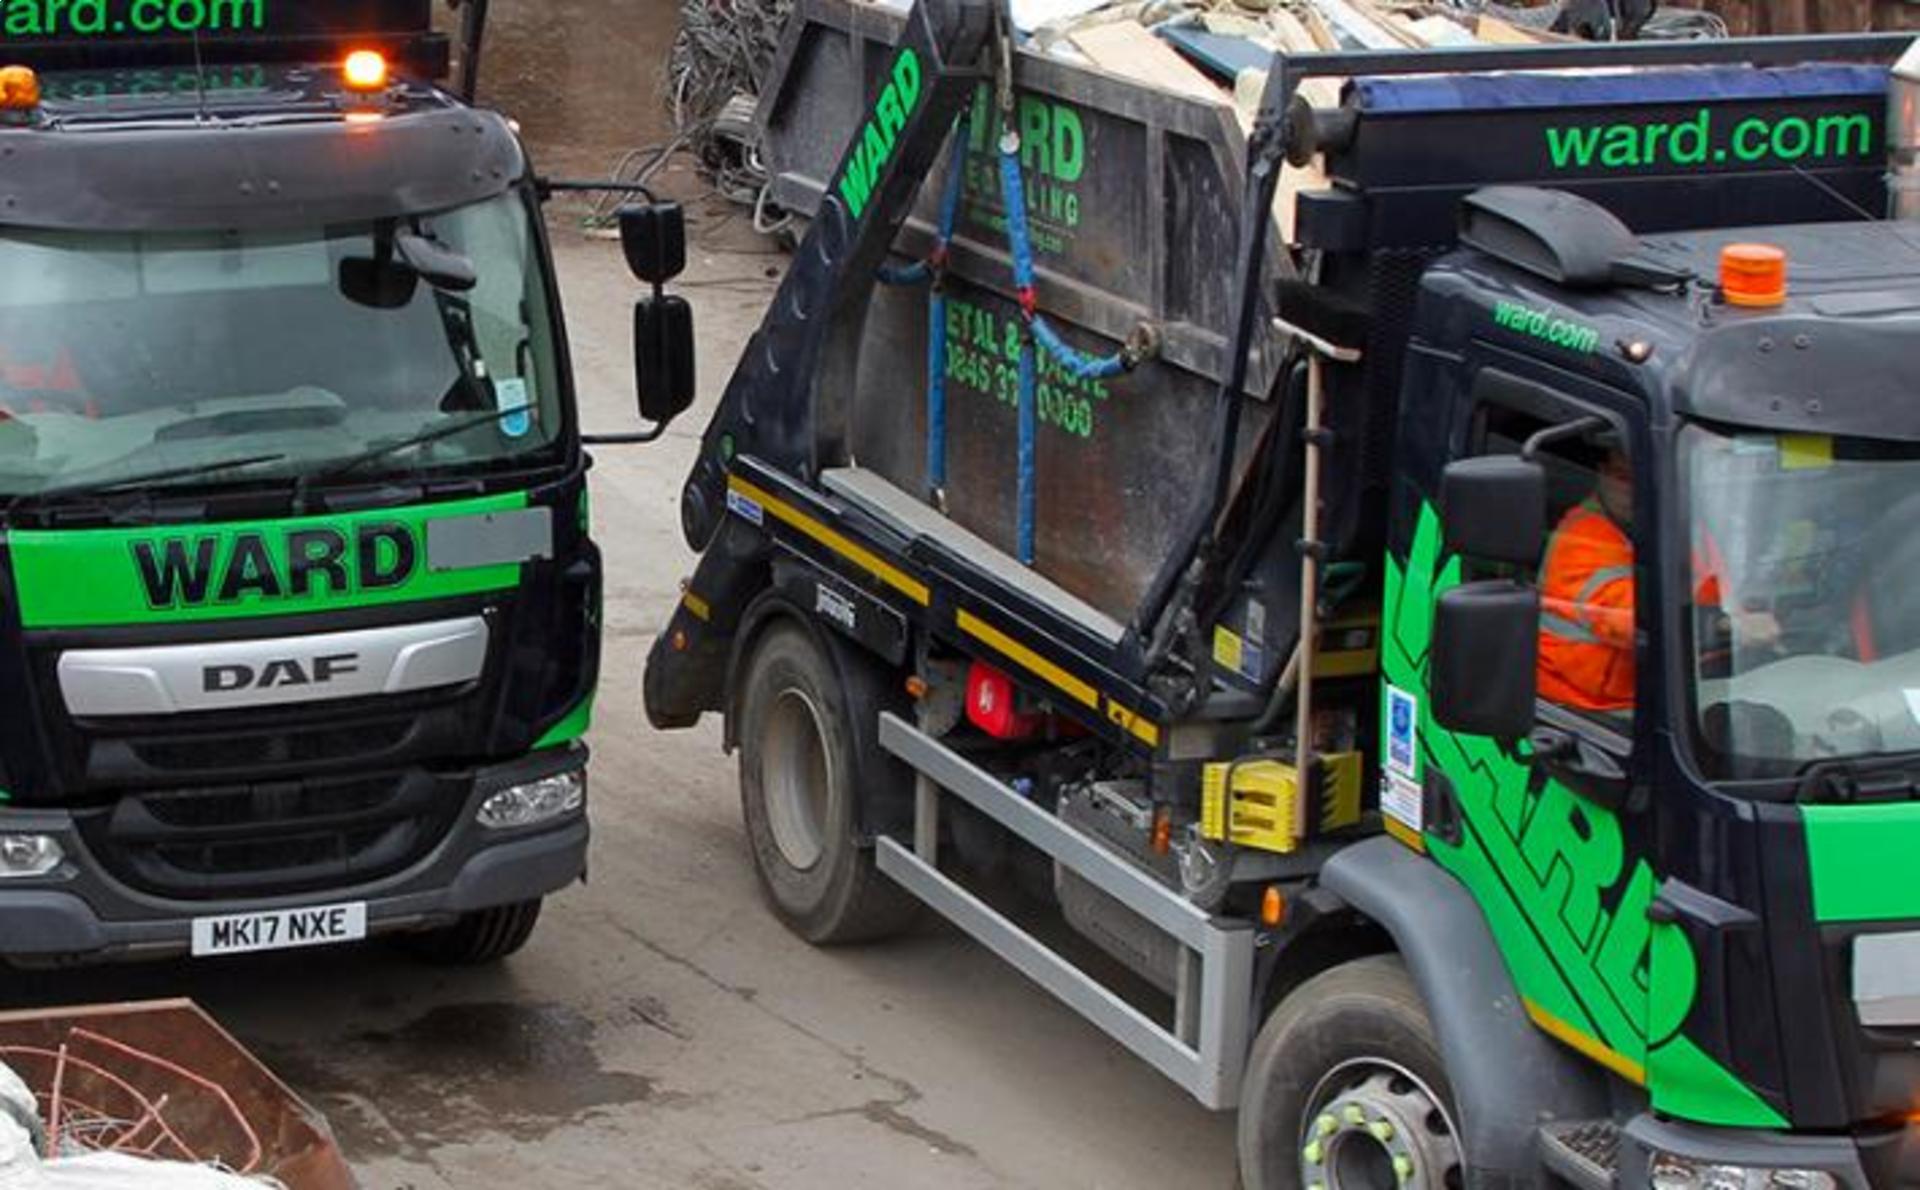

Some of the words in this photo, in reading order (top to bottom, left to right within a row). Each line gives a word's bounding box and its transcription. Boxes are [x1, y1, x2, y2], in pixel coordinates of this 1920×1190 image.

[0, 0, 265, 34] ard.com
[839, 48, 921, 219] WARD
[969, 82, 1085, 183] RD
[1546, 98, 1871, 168] ward.com
[946, 303, 999, 355] ETAL
[1495, 300, 1599, 353] ward.com
[130, 519, 417, 611] WARD
[203, 653, 358, 692] DAF
[211, 915, 280, 948] MK17
[289, 888, 346, 941] NXE
